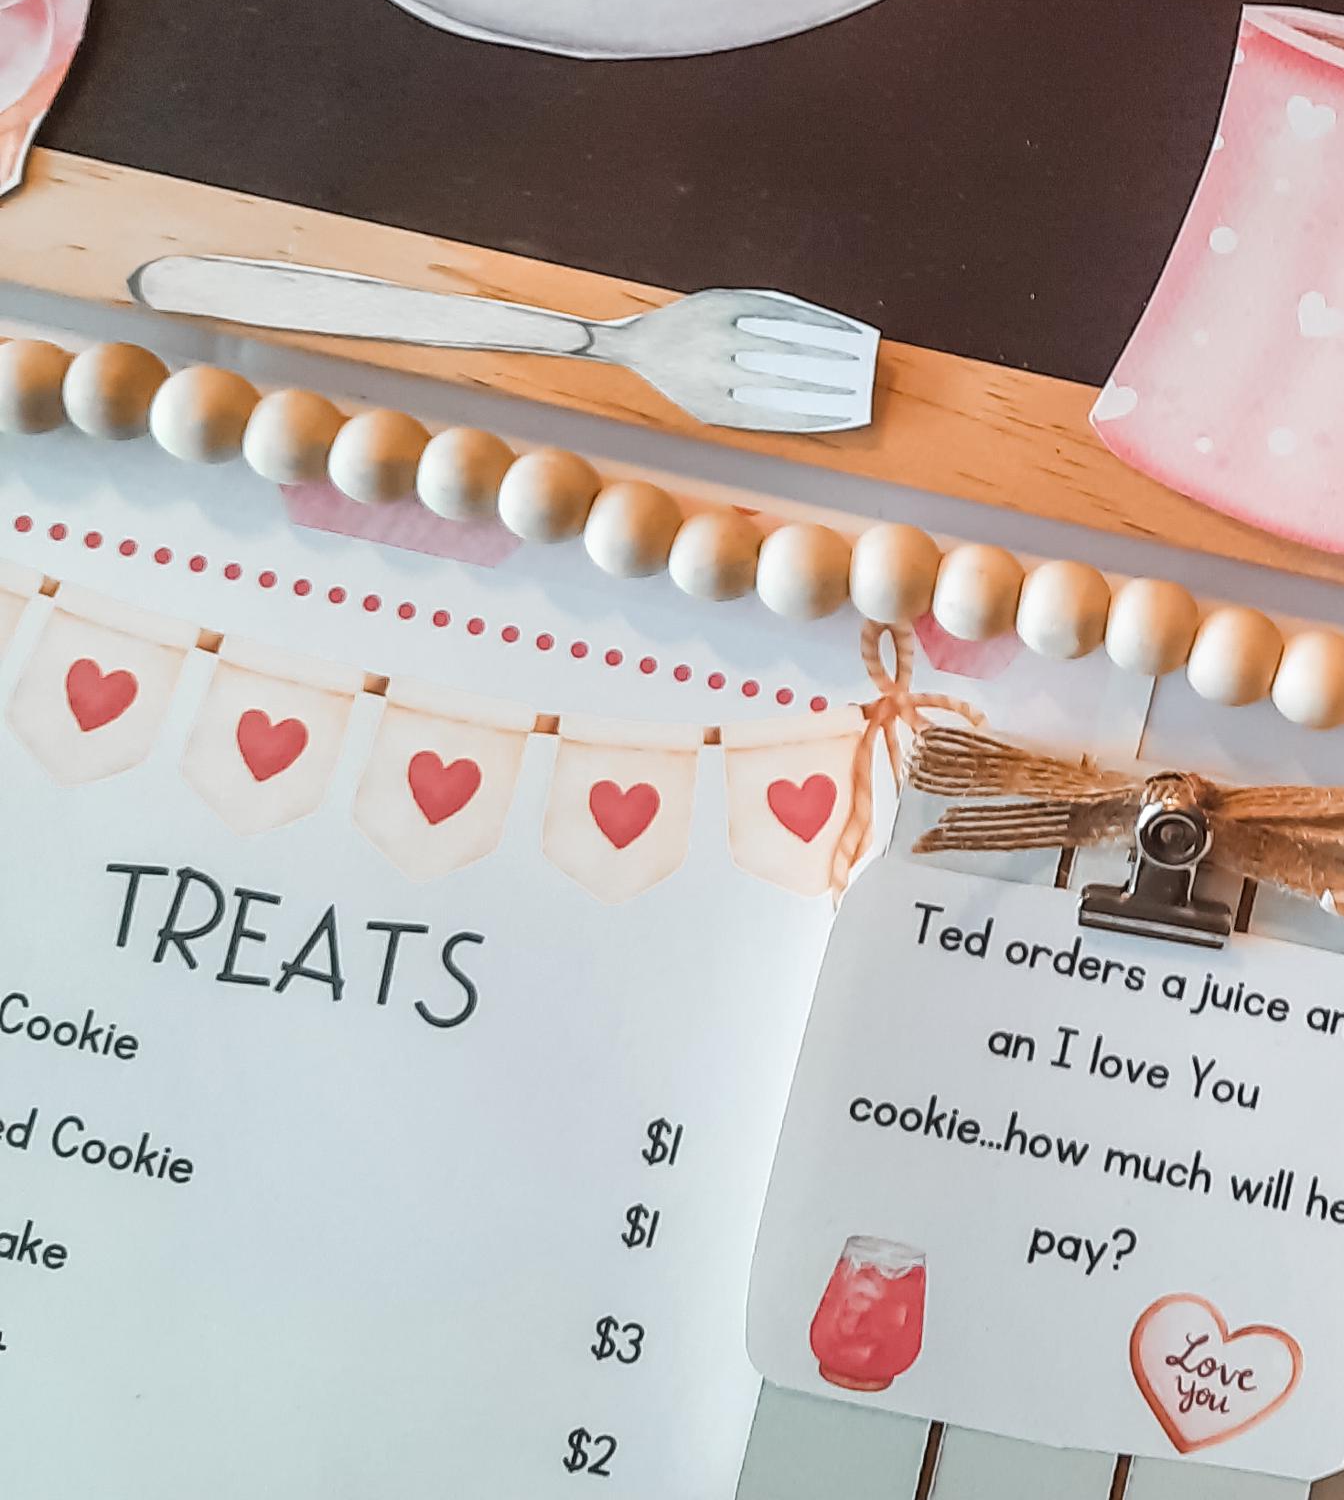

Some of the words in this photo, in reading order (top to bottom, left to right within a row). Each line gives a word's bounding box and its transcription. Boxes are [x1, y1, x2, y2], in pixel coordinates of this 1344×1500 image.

[106, 863, 485, 1029] TREATS
[914, 902, 995, 959] Ted
[1005, 936, 1145, 992] orders
[1162, 972, 1187, 1001] a
[1190, 972, 1290, 1022] juice
[0, 992, 139, 1060] Cookie
[987, 1027, 1035, 1062] an
[1050, 1026, 1079, 1069] I
[1089, 1034, 1170, 1089] love
[1190, 1054, 1260, 1110] You
[0, 1107, 38, 1151] d
[52, 1115, 194, 1185] Cookie
[642, 1118, 684, 1166] $1
[1103, 1145, 1212, 1194] much
[1230, 1168, 1294, 1213] will
[621, 1203, 660, 1249] $1
[1027, 1226, 1138, 1277] pay?
[591, 1315, 645, 1364] $3
[1165, 1332, 1257, 1392] Love
[1176, 1379, 1231, 1414] you
[563, 1427, 618, 1476] $2
